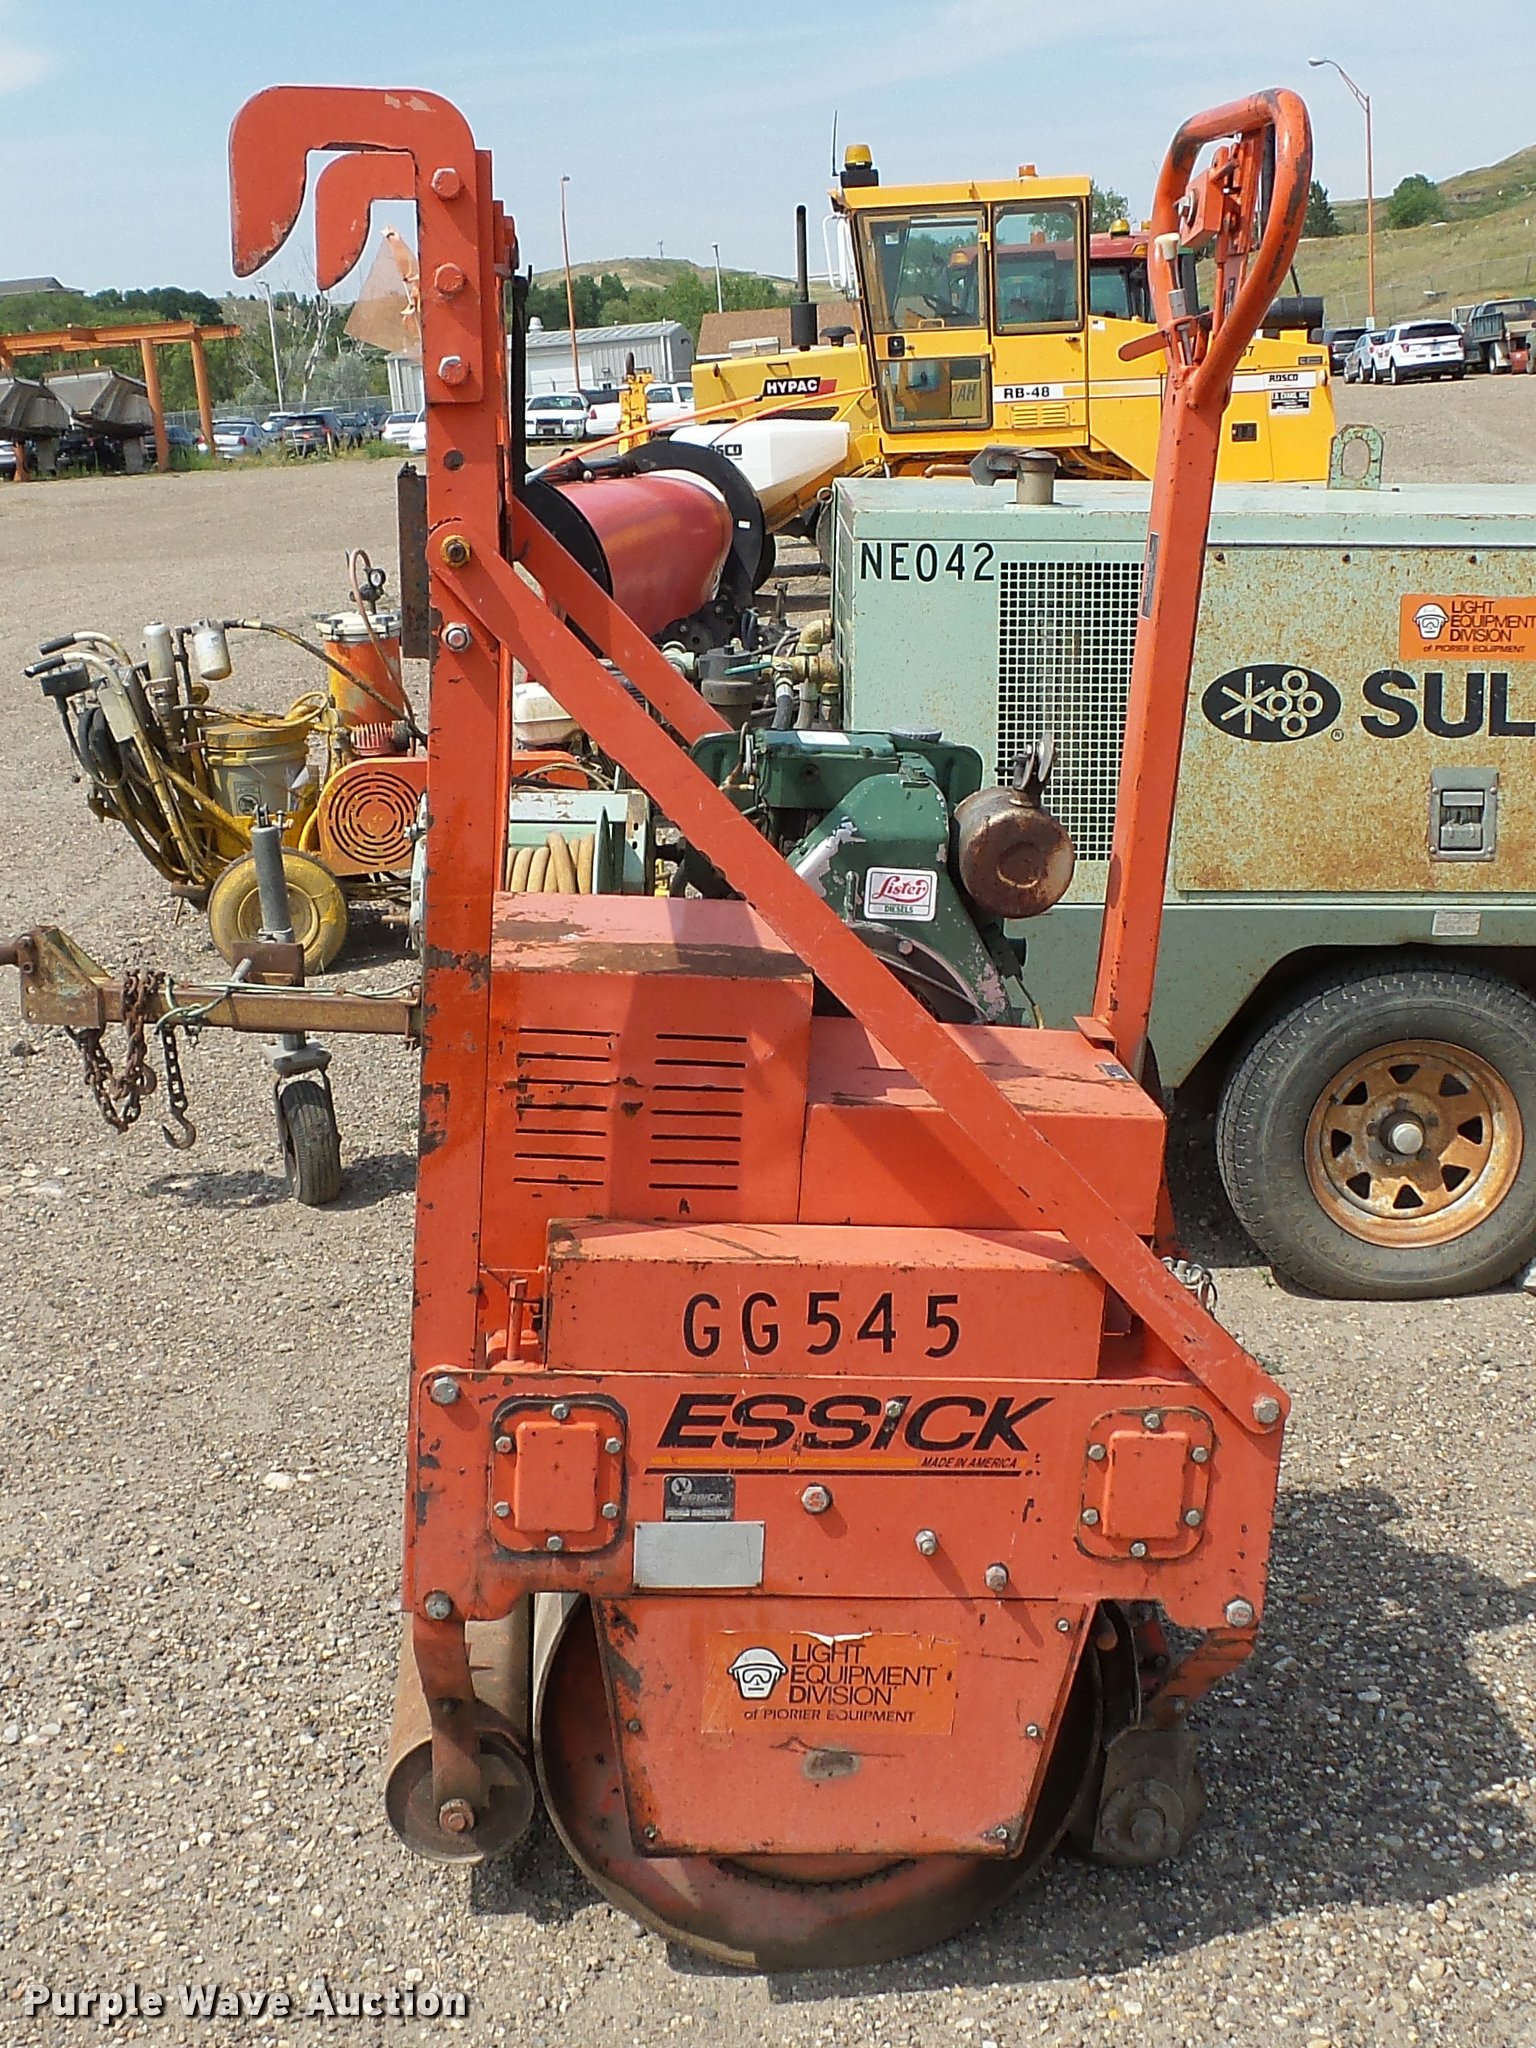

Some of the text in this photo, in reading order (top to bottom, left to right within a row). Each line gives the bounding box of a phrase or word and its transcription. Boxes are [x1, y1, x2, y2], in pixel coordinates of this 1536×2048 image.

[1268, 374, 1299, 383] ROSCO
[766, 379, 818, 394] HYPAC
[1004, 386, 1050, 399] RB-48
[860, 542, 995, 583] NE042
[1451, 600, 1495, 614] LIGHT
[1450, 614, 1536, 629] EQUIPMENT
[1449, 629, 1512, 643] DIVISION
[1472, 645, 1527, 653] EQUIPMENT
[871, 875, 930, 904] Lister
[884, 905, 914, 913] DIESELS
[656, 1394, 1054, 1451] ESSICK
[921, 1457, 1018, 1468] MADE IN AMERICA
[792, 1643, 866, 1664] LIGHT
[790, 1665, 938, 1687] EQUIPMENT
[788, 1686, 892, 1706] DIVISION
[744, 1709, 759, 1720] of
[827, 1710, 915, 1723] EQUIPMENT
